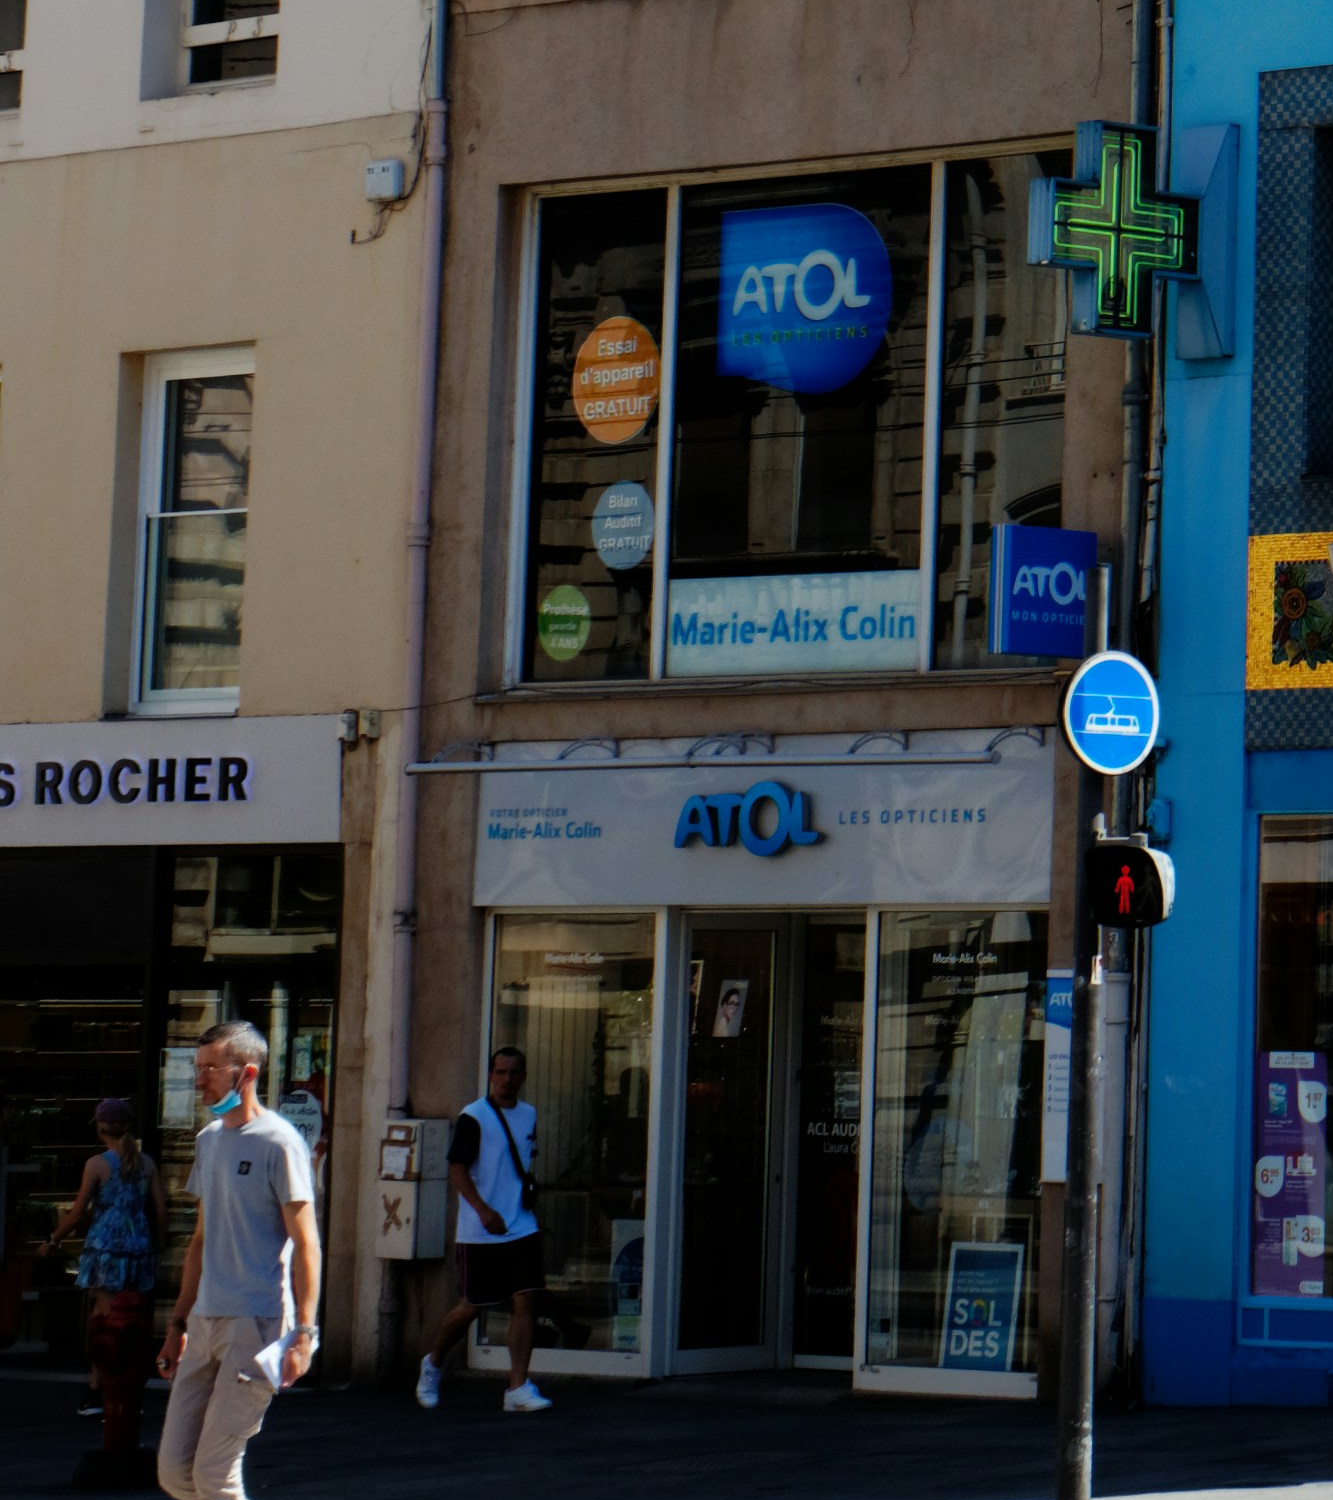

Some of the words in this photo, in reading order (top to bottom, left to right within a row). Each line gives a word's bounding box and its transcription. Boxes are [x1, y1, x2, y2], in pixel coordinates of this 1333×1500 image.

[732, 249, 871, 321] ATOL
[597, 335, 637, 357] Essai
[732, 330, 761, 347] LES
[770, 325, 869, 344] OPTICIENS
[580, 360, 654, 387] d'appareil
[583, 395, 652, 421] GRATUIT
[609, 494, 638, 508] Bilan
[604, 514, 642, 529] Auditif
[599, 534, 650, 552] GRATUIT
[1013, 562, 1087, 606] ATOL
[672, 607, 828, 647] Marie-Alix
[839, 603, 916, 641] Colin
[1012, 610, 1037, 622] MON
[1042, 612, 1086, 626] OPTICIE
[34, 757, 249, 805] ROCHER
[674, 780, 824, 858] ATOL
[838, 810, 871, 825] LES
[880, 808, 987, 825] OPTICIENS
[488, 822, 561, 839] Marie-Alix
[565, 821, 602, 838] Colin
[950, 1329, 1001, 1359] DES
